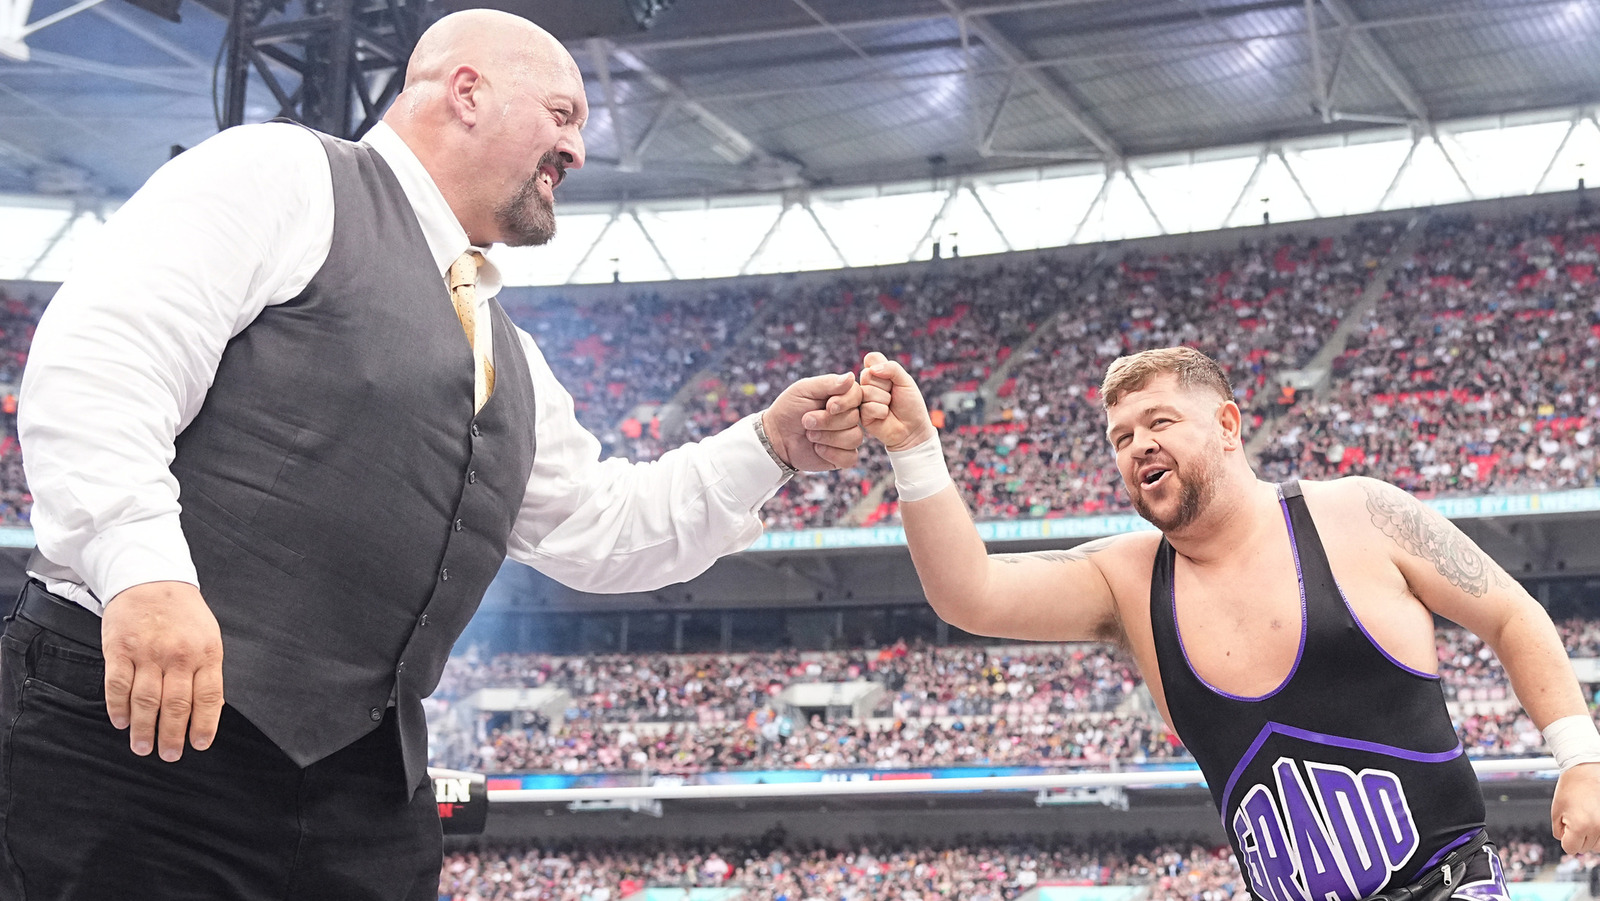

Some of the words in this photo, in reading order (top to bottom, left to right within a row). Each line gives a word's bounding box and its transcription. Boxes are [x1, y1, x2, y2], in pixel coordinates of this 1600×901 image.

[1481, 497, 1505, 515] BY
[771, 532, 793, 548] BY
[794, 531, 811, 547] EE
[824, 528, 898, 547] WEMBLEY
[996, 523, 1020, 540] BY
[1021, 521, 1039, 538] EE
[1051, 515, 1131, 538] WEMBLEY
[435, 778, 471, 802] IN
[1233, 756, 1420, 901] GRADO
